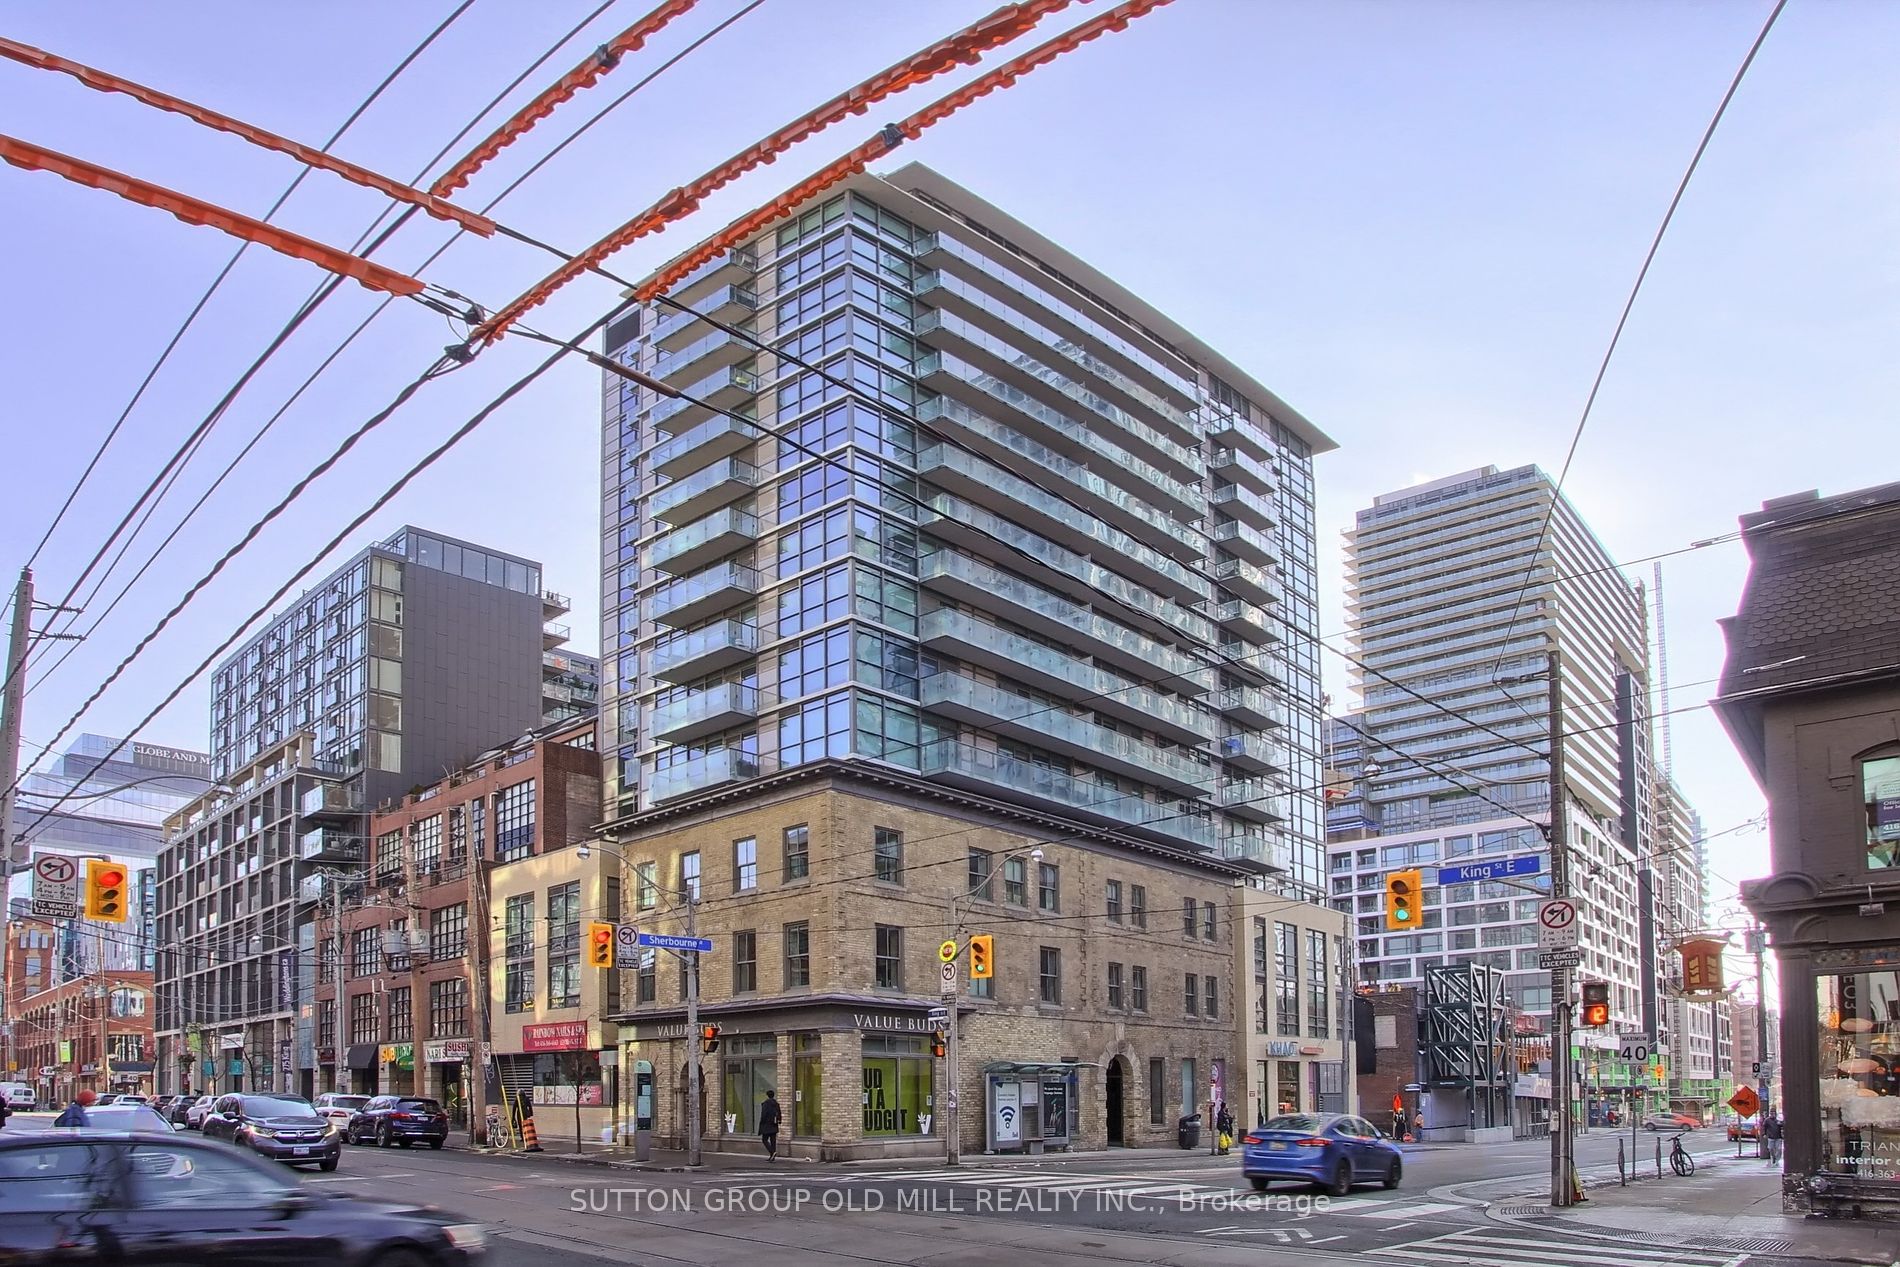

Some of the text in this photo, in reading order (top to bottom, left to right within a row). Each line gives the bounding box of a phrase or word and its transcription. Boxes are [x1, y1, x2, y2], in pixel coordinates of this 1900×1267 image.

[132, 745, 171, 759] GLOBE
[172, 752, 198, 763] AND
[1460, 860, 1515, 879] King St E
[34, 908, 75, 917] EXCEPTED
[649, 935, 698, 948] Sherbourne
[854, 1014, 902, 1029] VALUE
[1593, 1006, 1604, 1023] 2
[1621, 1045, 1647, 1061] 40
[876, 1088, 886, 1110] A
[1835, 1154, 1892, 1166] interior
